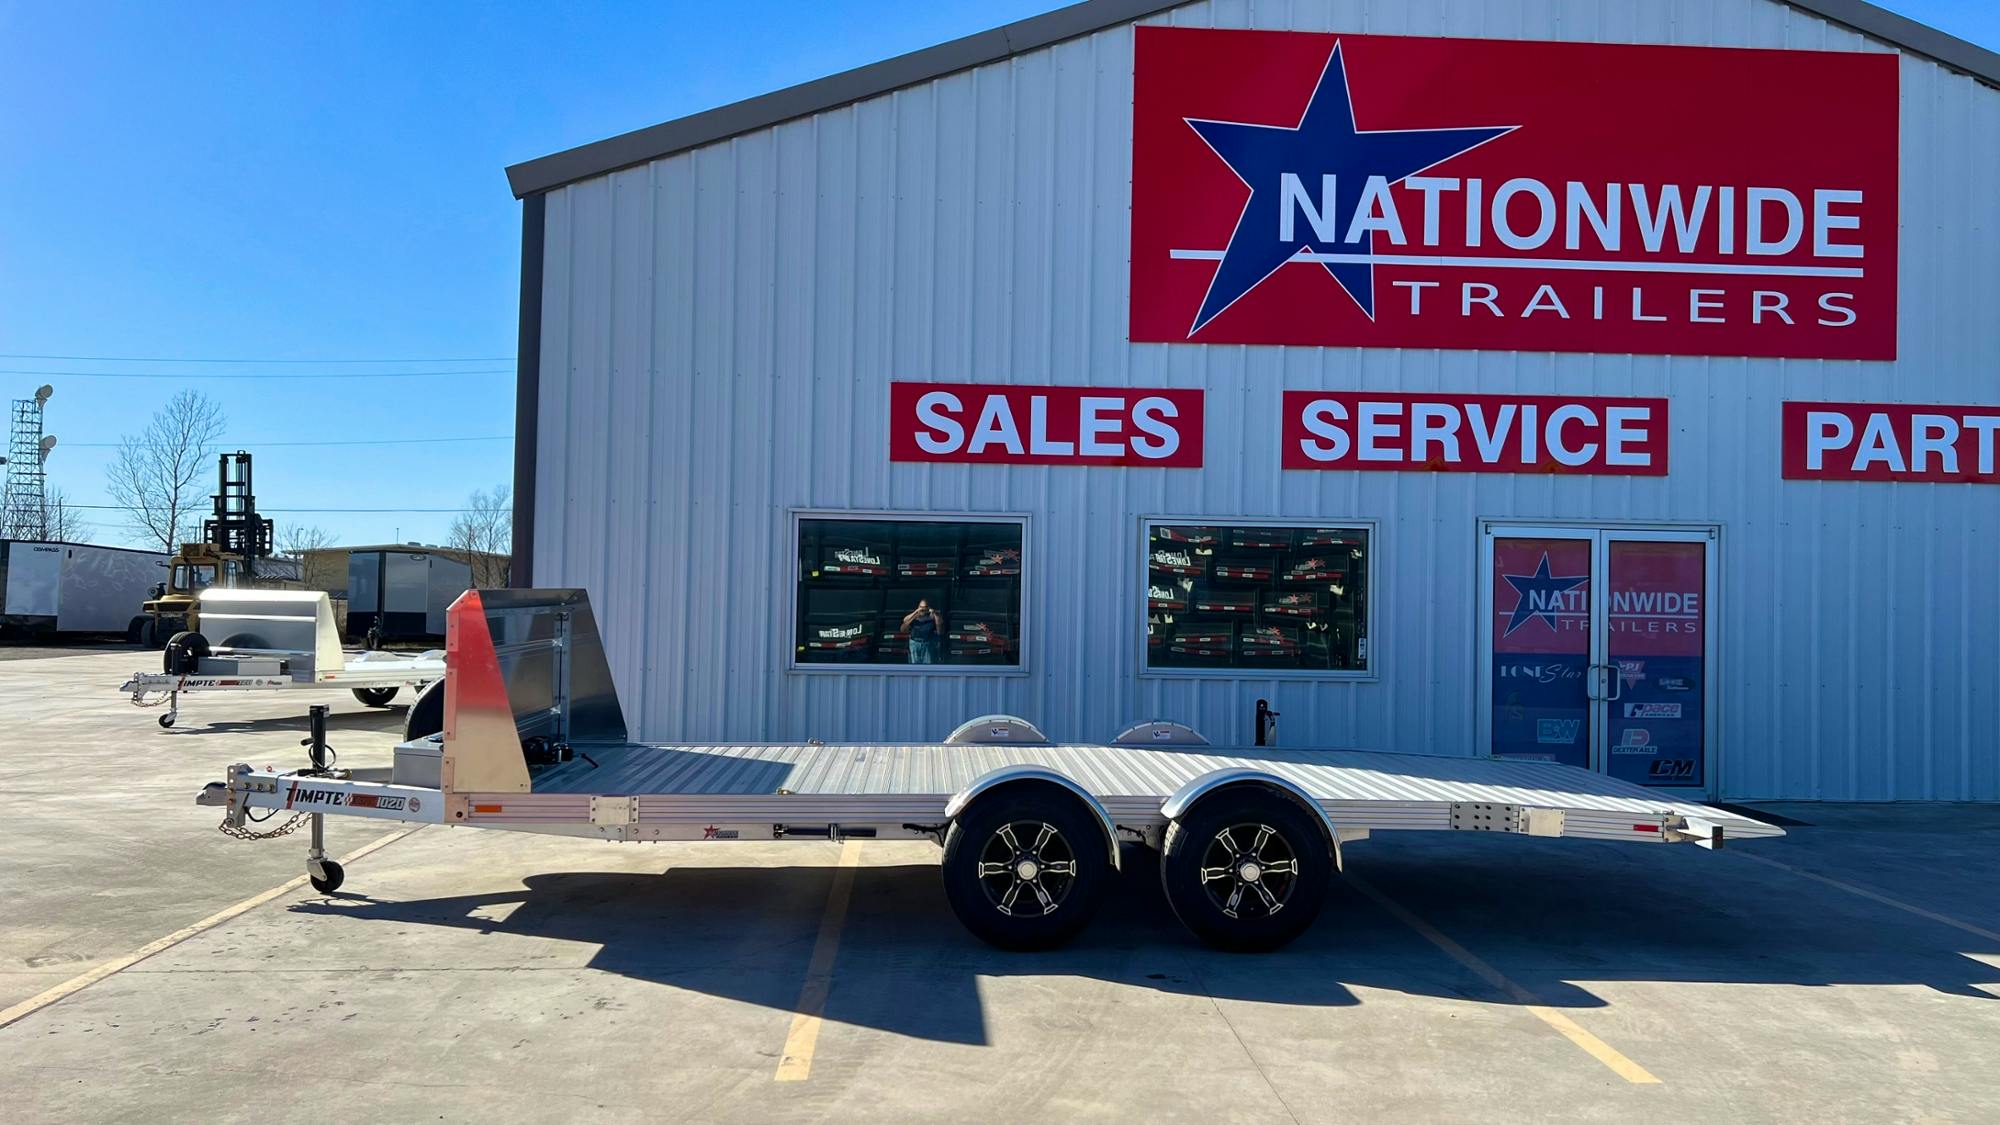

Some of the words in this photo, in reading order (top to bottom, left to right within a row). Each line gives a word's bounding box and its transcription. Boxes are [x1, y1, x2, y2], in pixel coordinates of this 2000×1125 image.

[1278, 172, 1865, 259] NATIONWIDE
[1392, 280, 1858, 328] TRAILERS
[914, 391, 1180, 459] SALES
[1299, 398, 1652, 468] SERVICE
[1806, 411, 2000, 474] PART
[1528, 588, 1699, 614] NATINWIDE
[285, 785, 345, 807] TIMPTE
[375, 795, 405, 810] 1020
